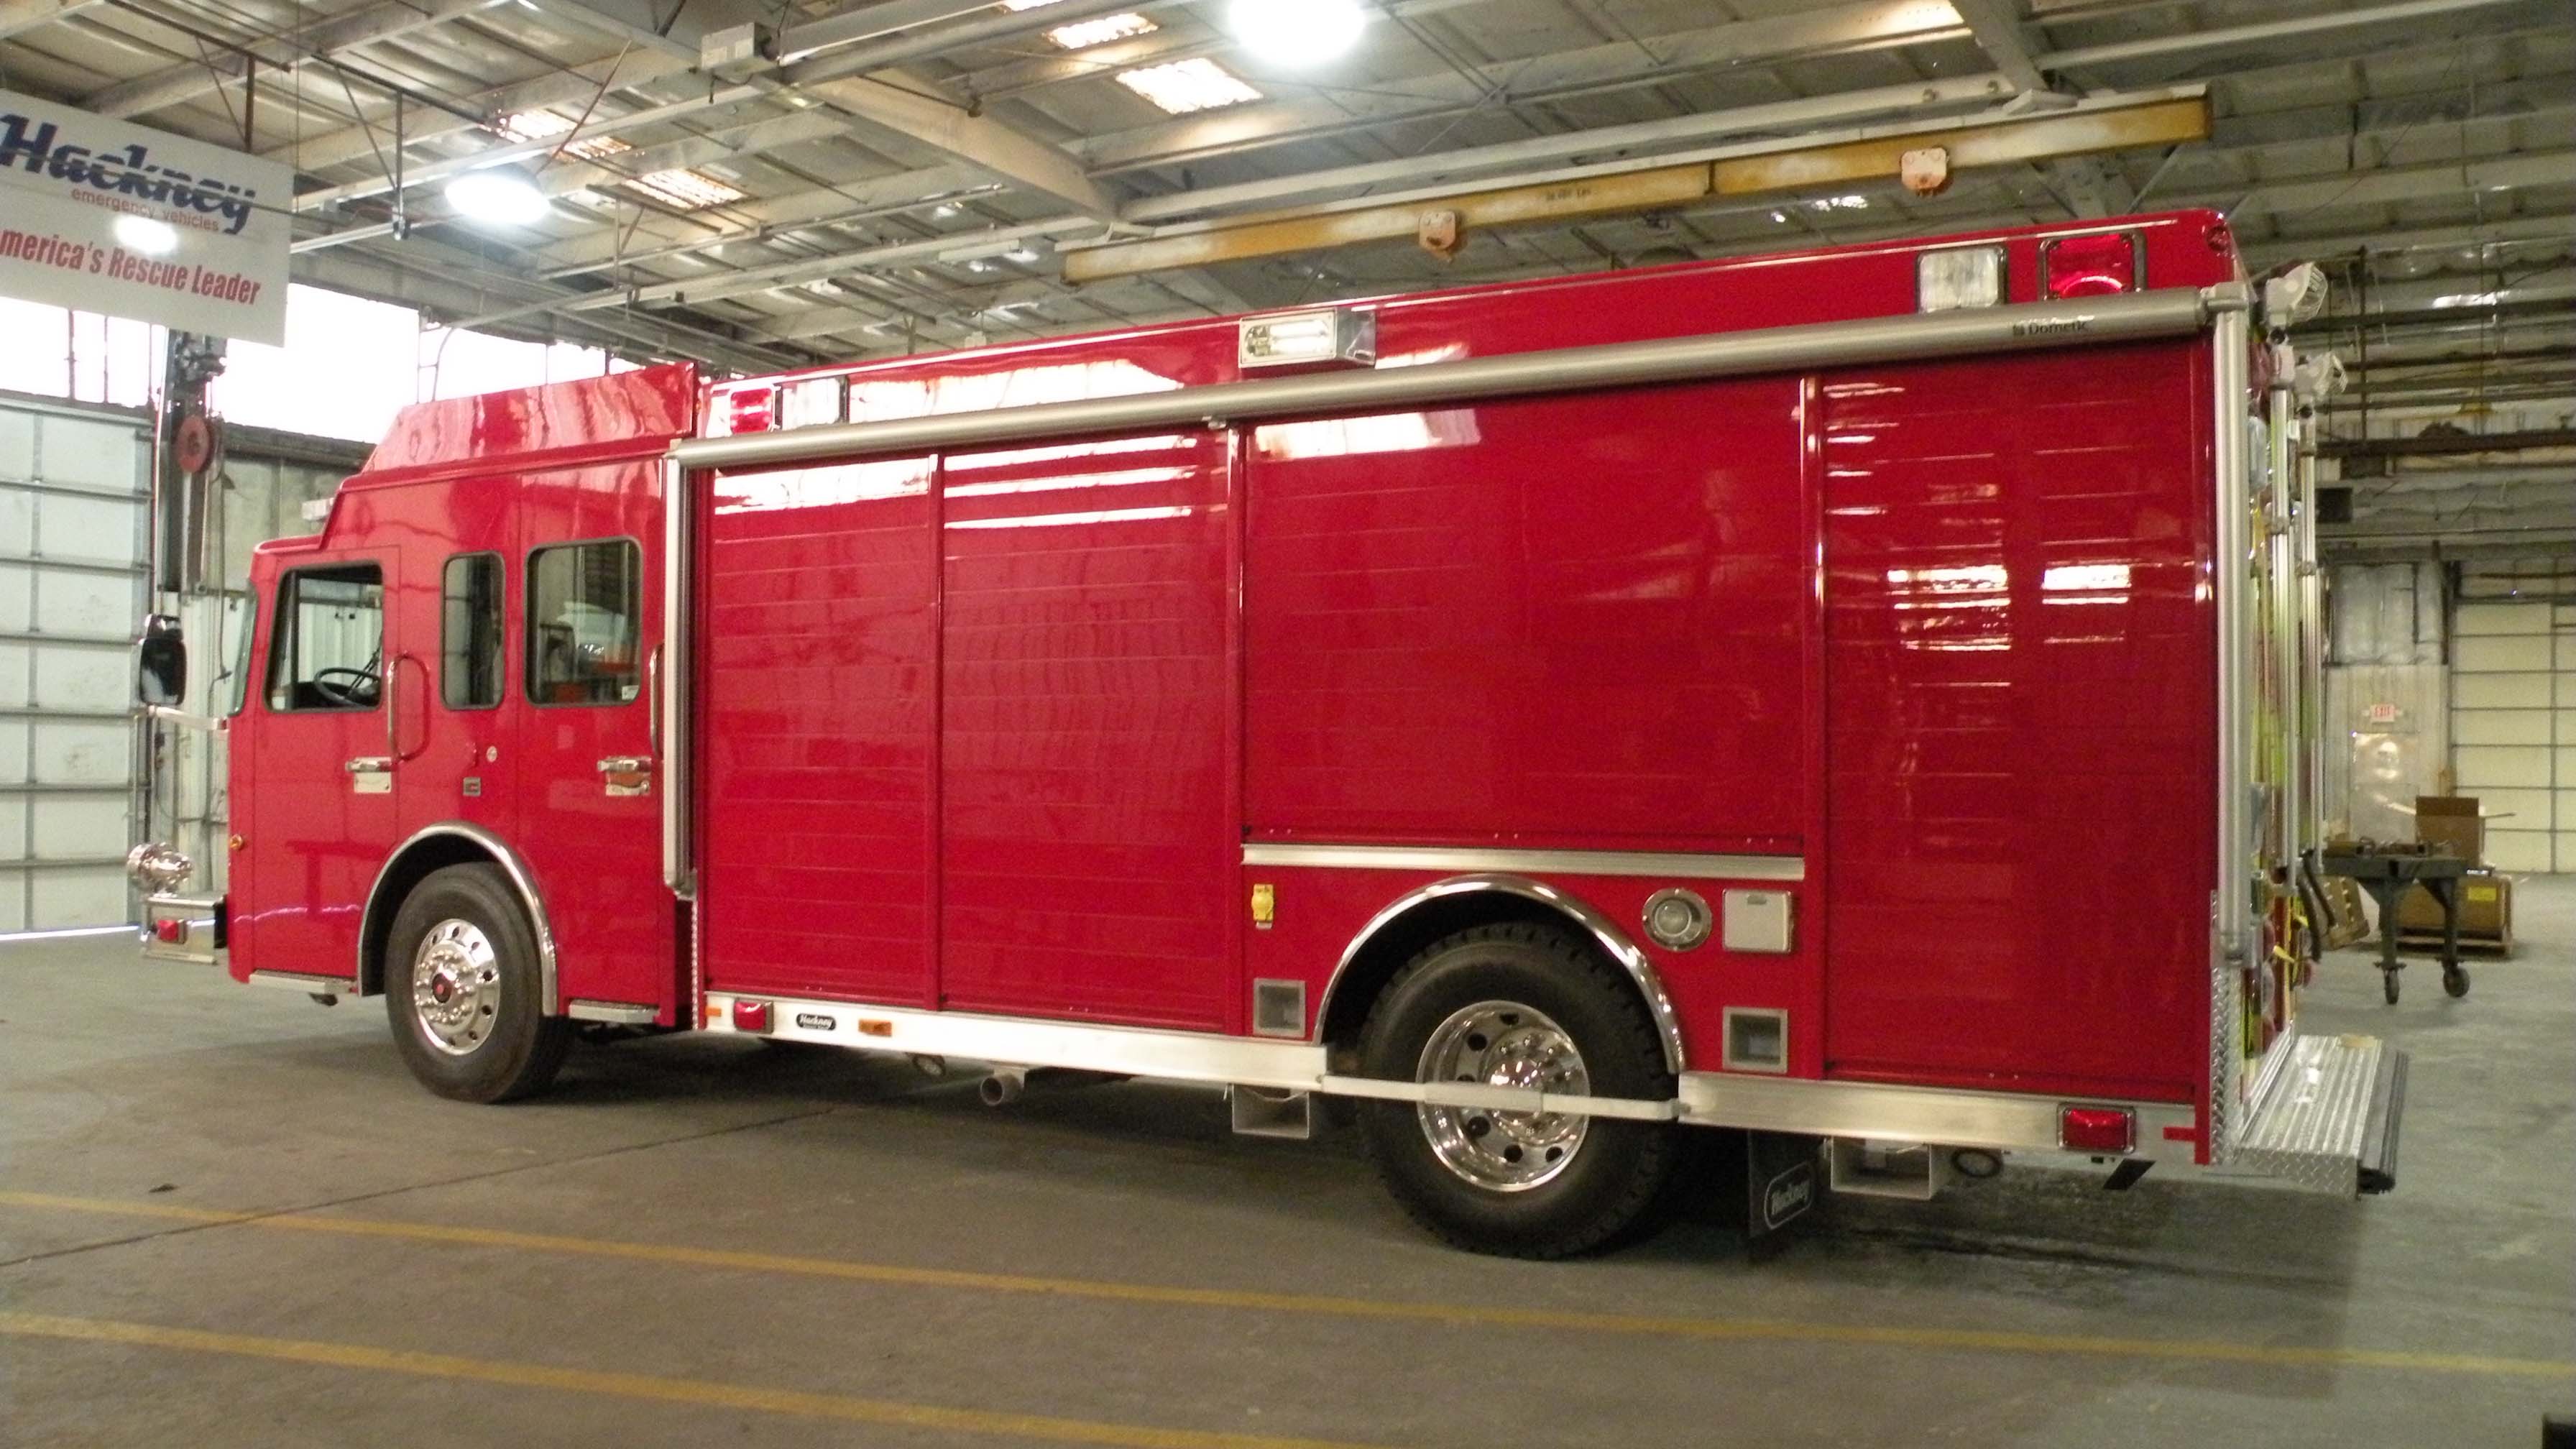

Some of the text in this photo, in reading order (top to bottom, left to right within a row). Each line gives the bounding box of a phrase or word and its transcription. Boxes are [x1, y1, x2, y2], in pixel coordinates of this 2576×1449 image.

[0, 114, 256, 234] Hackney
[72, 187, 219, 232] emergency vehicles
[0, 229, 261, 305] merica's Rescue Leader
